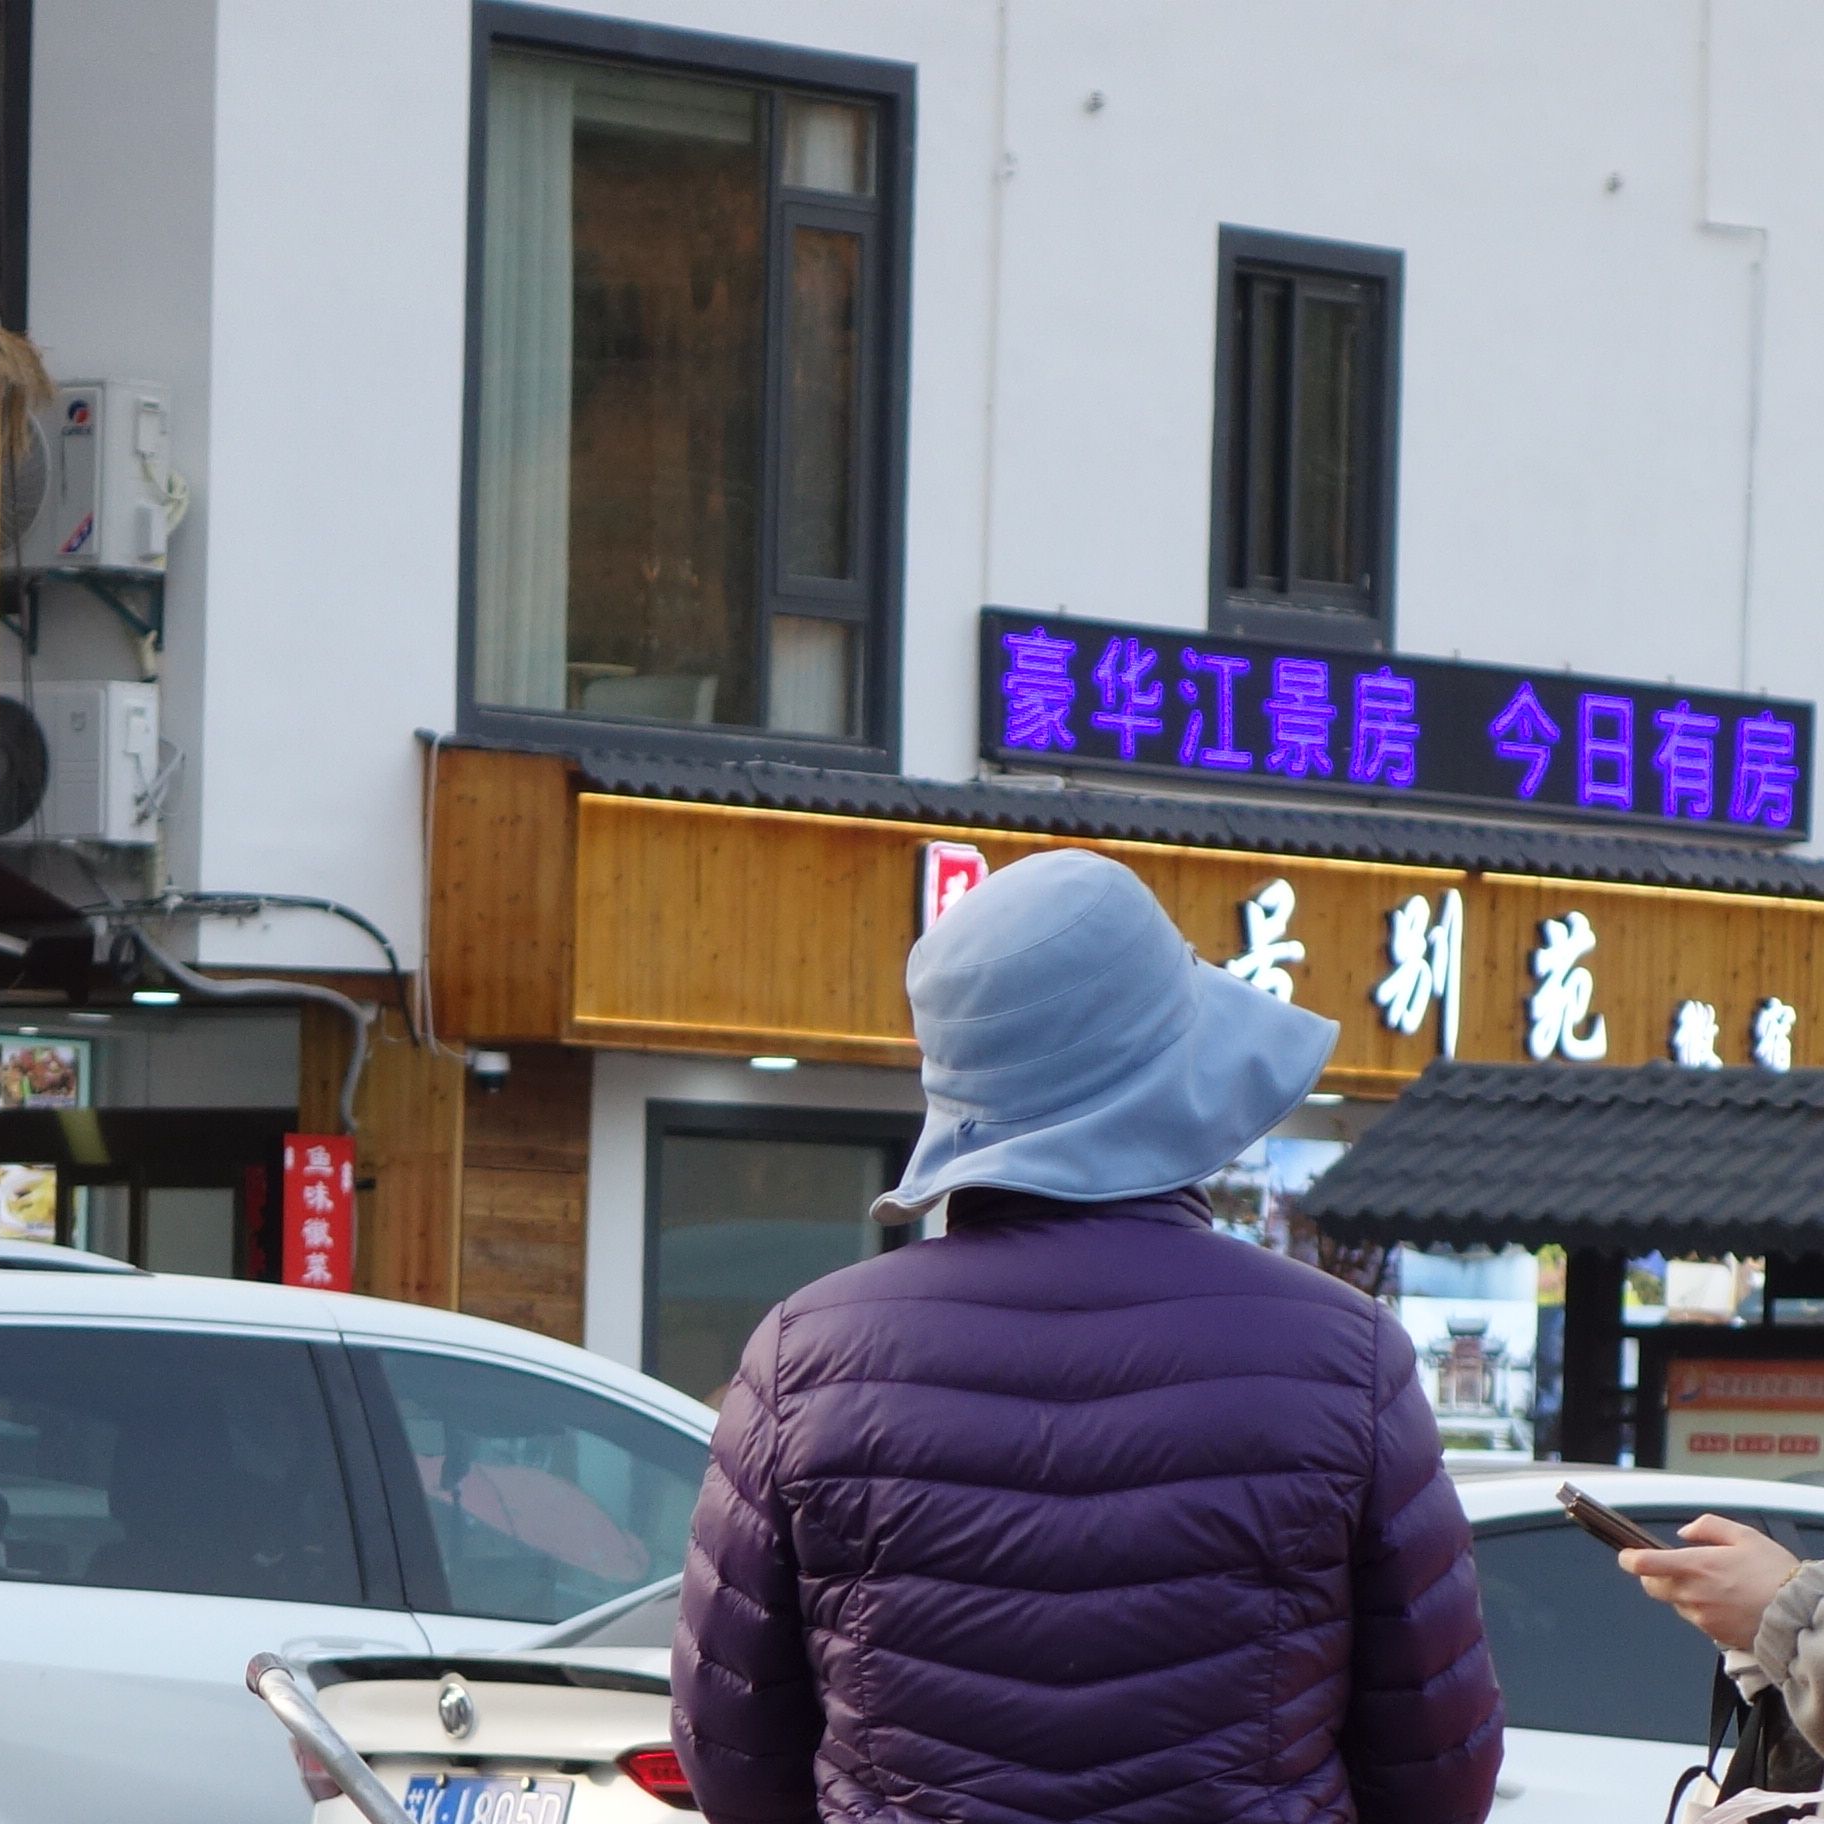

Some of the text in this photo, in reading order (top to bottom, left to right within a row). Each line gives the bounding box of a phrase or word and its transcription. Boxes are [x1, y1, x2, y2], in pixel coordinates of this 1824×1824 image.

[1001, 625, 1800, 828] 豪华江景房 今日有房
[300, 1144, 335, 1285] 鱼味徽菜
